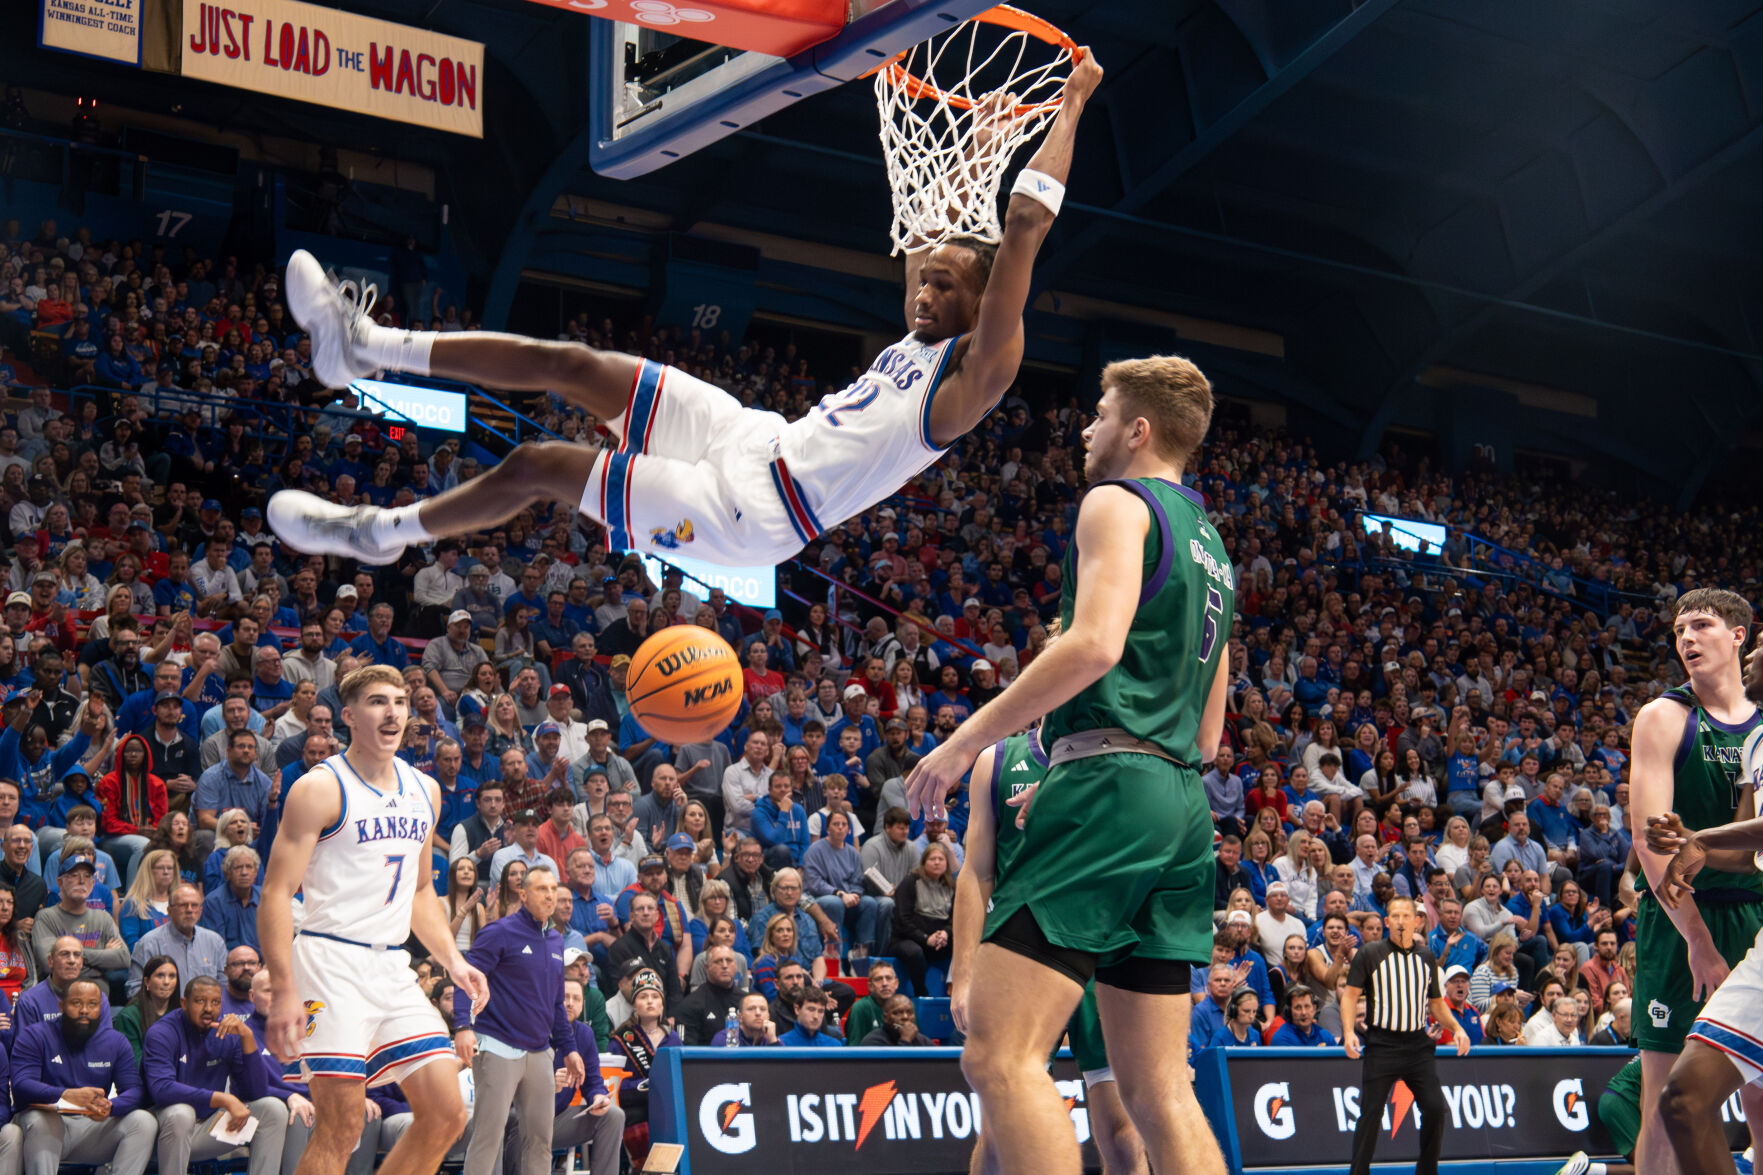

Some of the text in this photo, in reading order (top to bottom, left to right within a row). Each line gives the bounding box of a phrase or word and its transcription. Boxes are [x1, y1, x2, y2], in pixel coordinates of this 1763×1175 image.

[48, 9, 136, 36] WINNINGEST COACH
[50, 0, 134, 23] KANSAS ALL-TIME
[190, 2, 477, 110] JUST LOAD THE WAGON
[156, 210, 193, 238] 17
[692, 304, 721, 329] 18
[386, 399, 452, 424] MIDCO
[389, 426, 406, 442] EXIT
[683, 677, 734, 709] NCAA
[354, 816, 428, 844] KANSAS
[383, 854, 407, 906] 7
[699, 1082, 757, 1154] G
[786, 1093, 825, 1142] IS
[824, 1094, 857, 1142] IT
[883, 1093, 922, 1140] IN
[1253, 1081, 1296, 1140] G
[1440, 1083, 1516, 1129] YOU?
[1552, 1078, 1590, 1131] G
